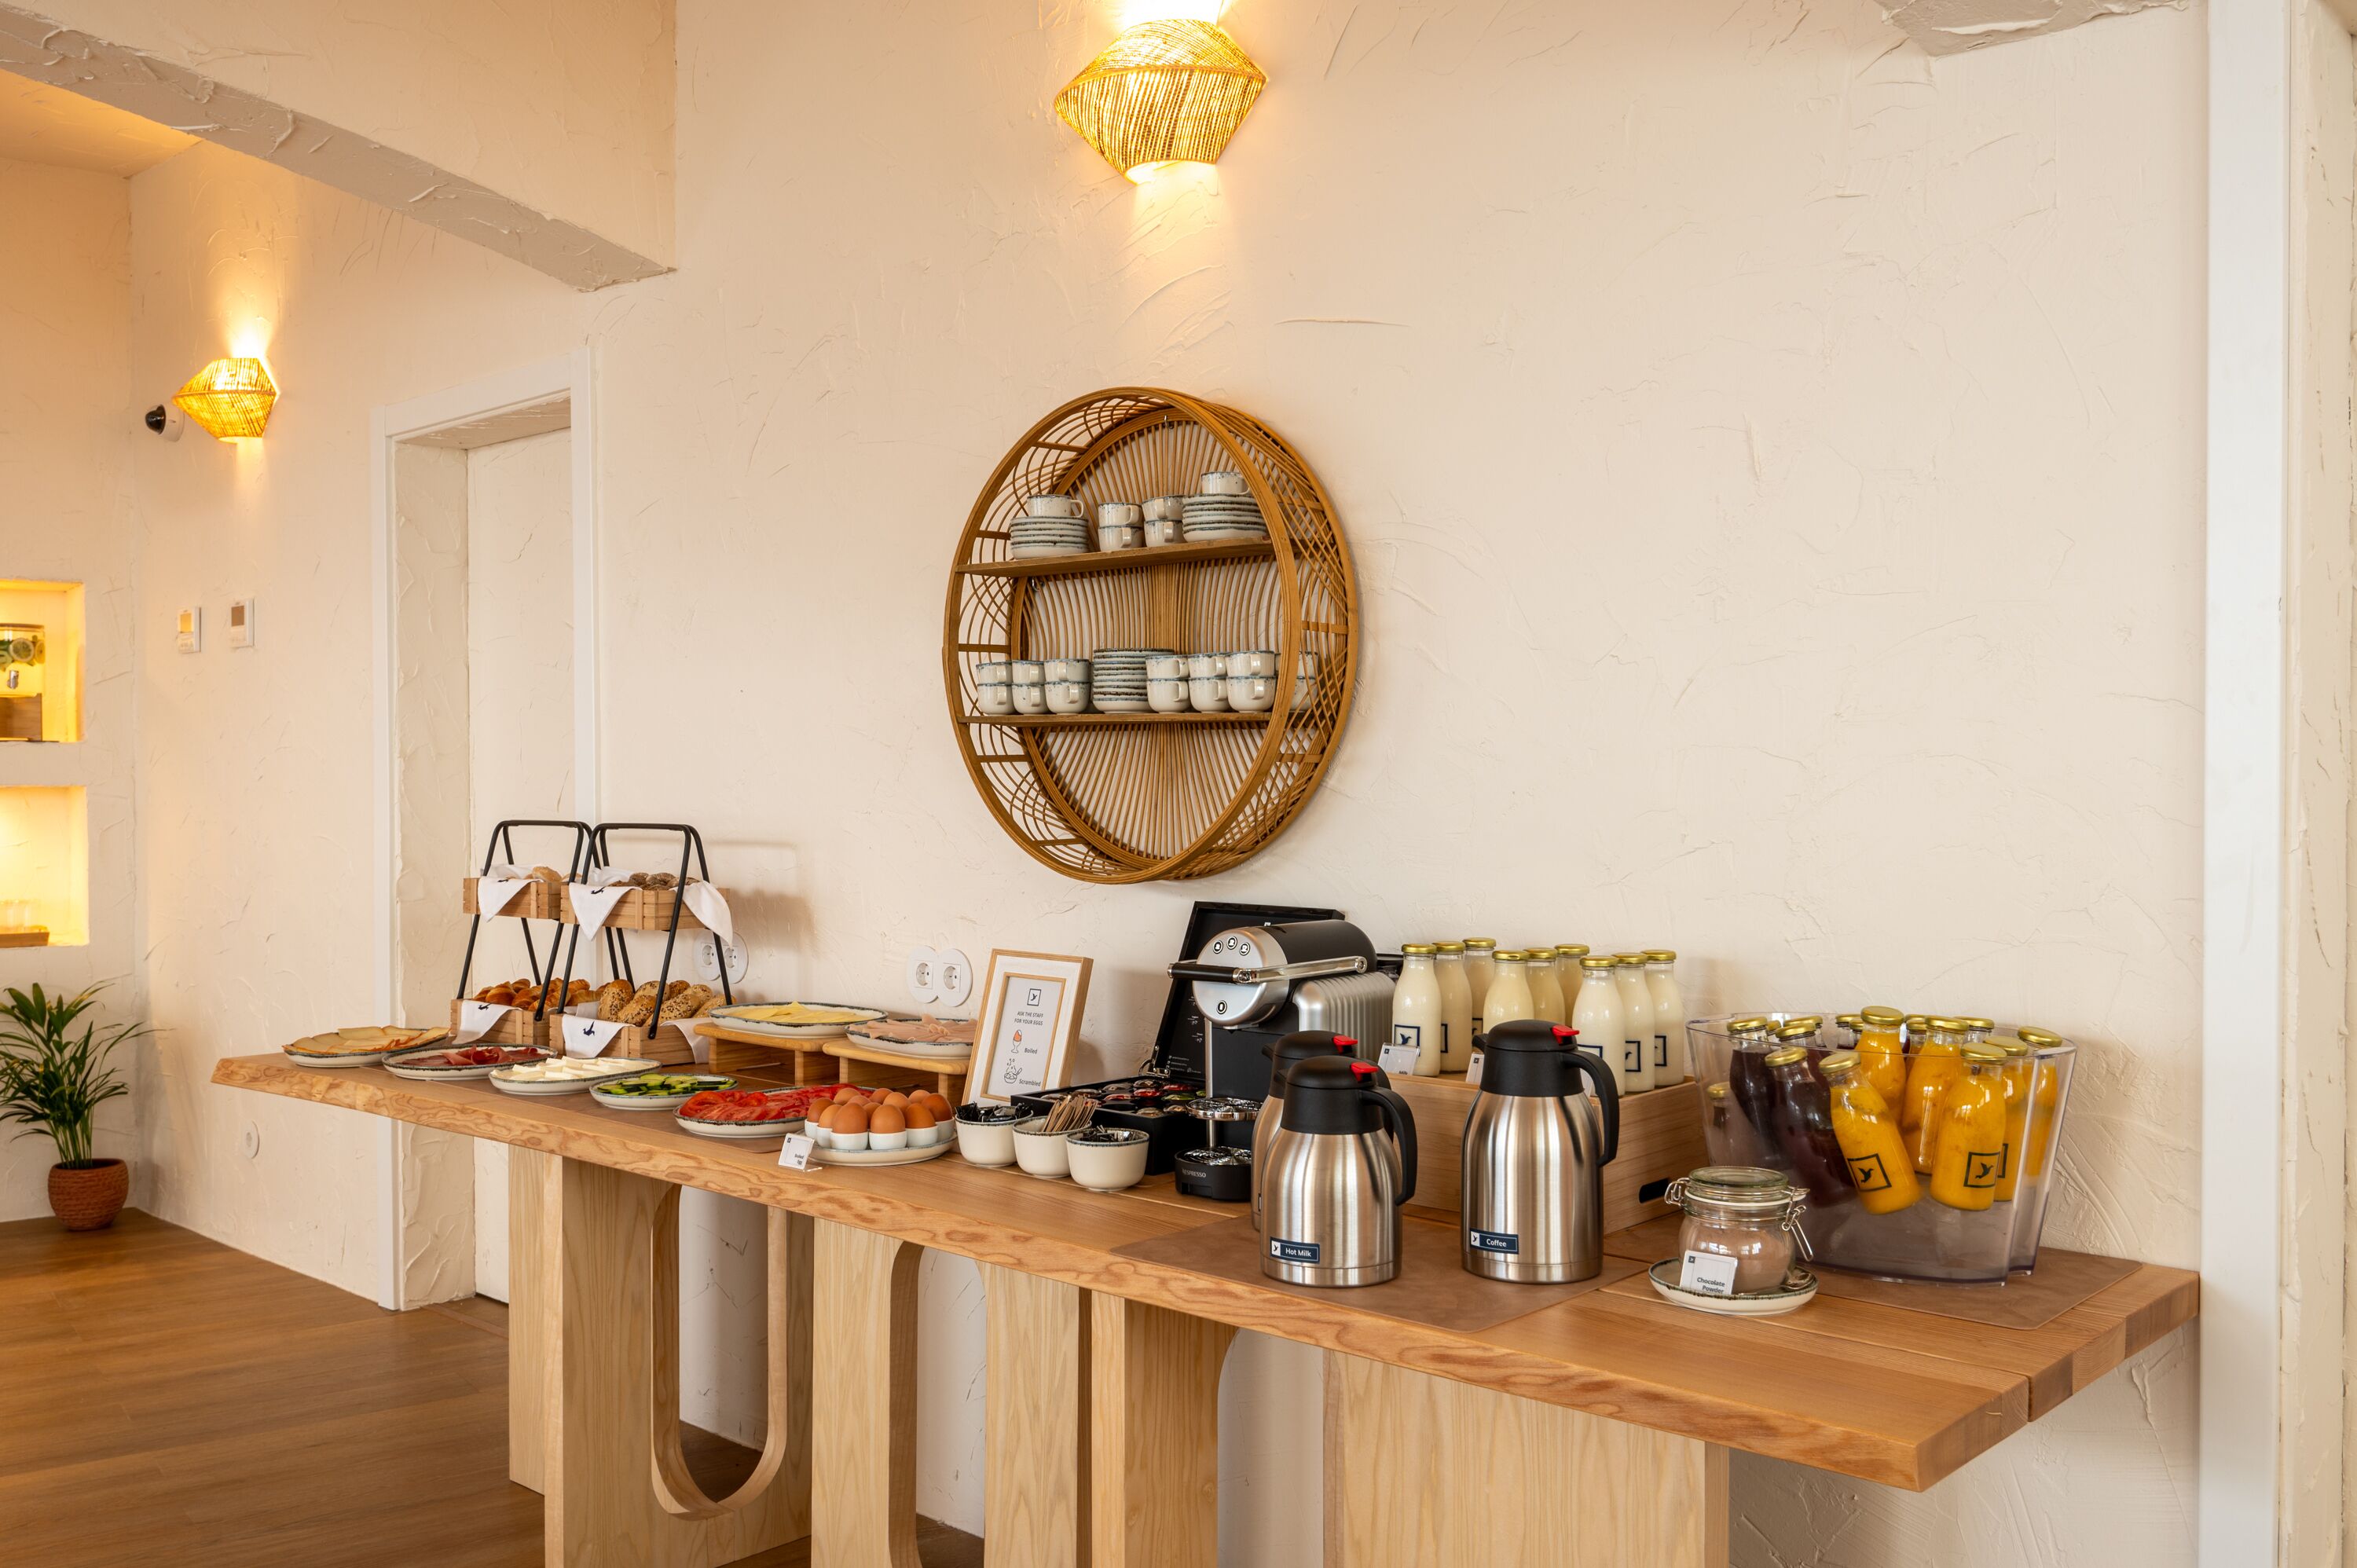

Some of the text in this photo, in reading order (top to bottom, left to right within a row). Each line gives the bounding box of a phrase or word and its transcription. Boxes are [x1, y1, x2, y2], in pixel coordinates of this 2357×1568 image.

[1018, 1078, 1041, 1086] Scrambled
[1182, 1168, 1207, 1178] NESPRESSO
[1486, 1238, 1507, 1247] Coffee
[1297, 1249, 1311, 1258] Milk
[1696, 1277, 1725, 1288] Chocolate
[1702, 1285, 1724, 1295] Powder
